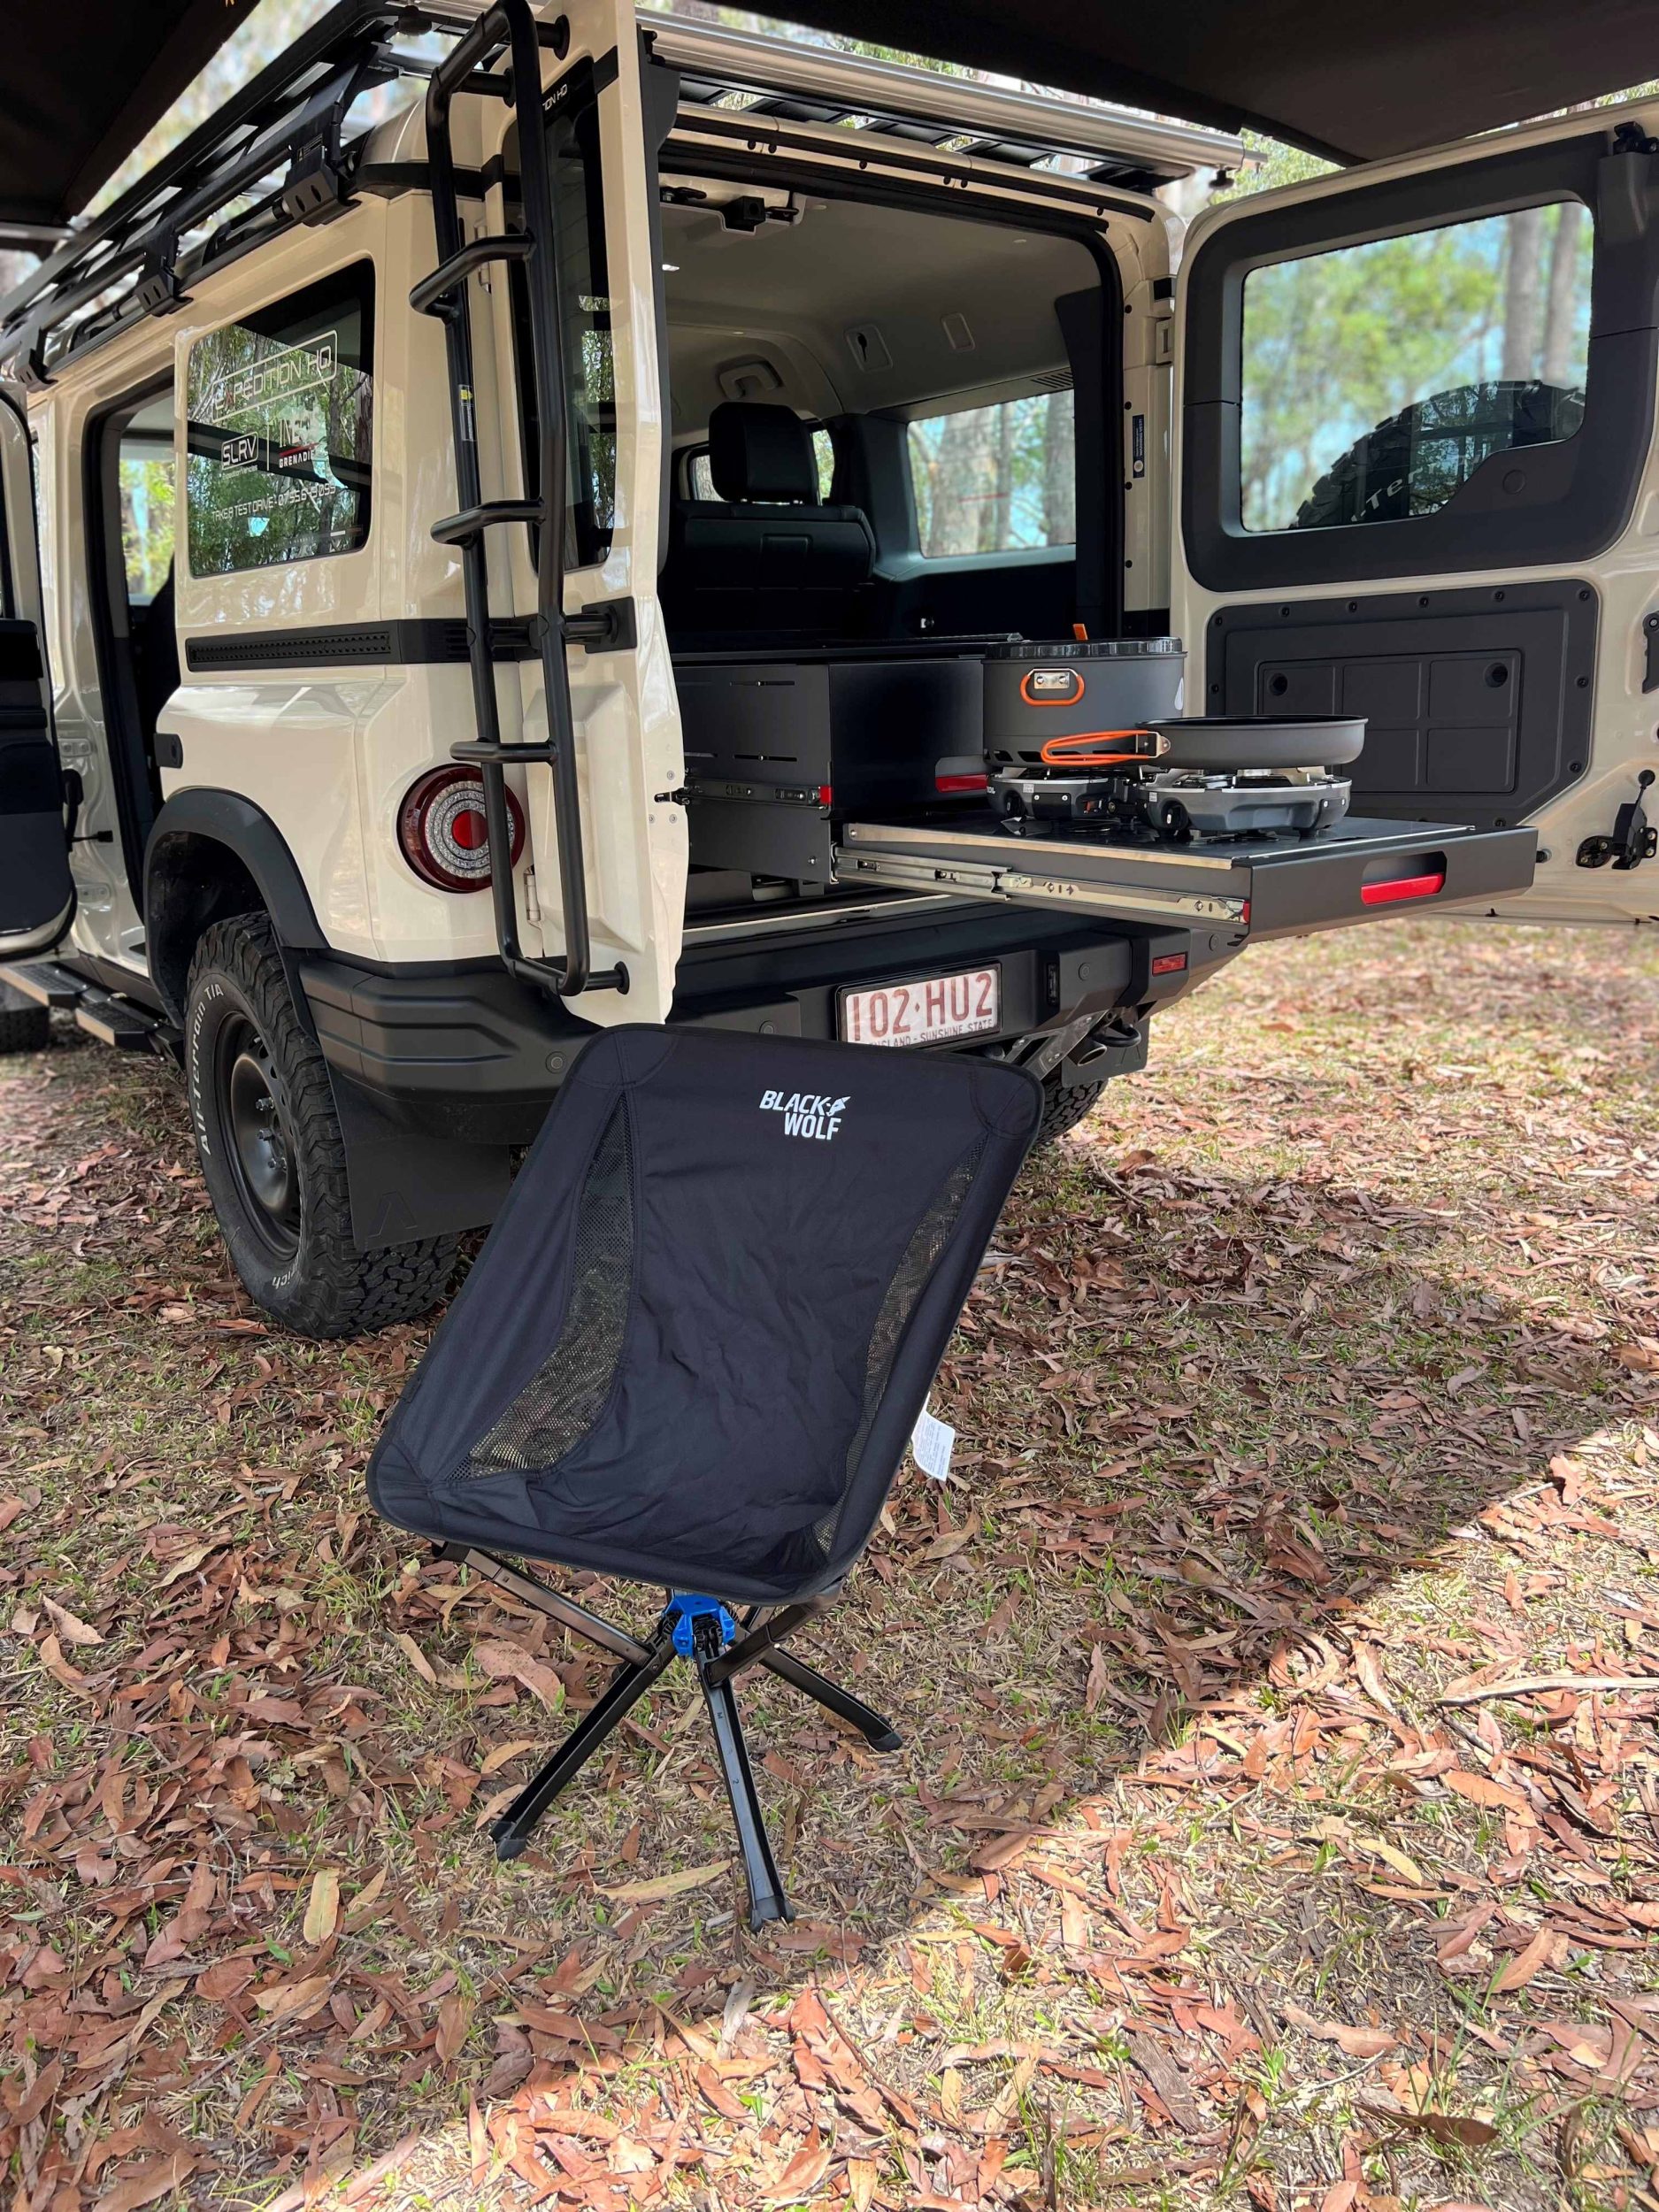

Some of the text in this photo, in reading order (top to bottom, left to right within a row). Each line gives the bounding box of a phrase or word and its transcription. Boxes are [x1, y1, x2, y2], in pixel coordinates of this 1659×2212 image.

[307, 345, 332, 374] HQ
[223, 434, 257, 467] SLRV
[279, 449, 316, 469] GRENADIE
[234, 502, 251, 518] TEST
[204, 983, 224, 1001] T/A
[919, 1025, 964, 1042] SUNSHINE
[967, 1018, 993, 1033] STATE
[759, 1089, 832, 1117] BLACK
[784, 1111, 842, 1141] WOLF
